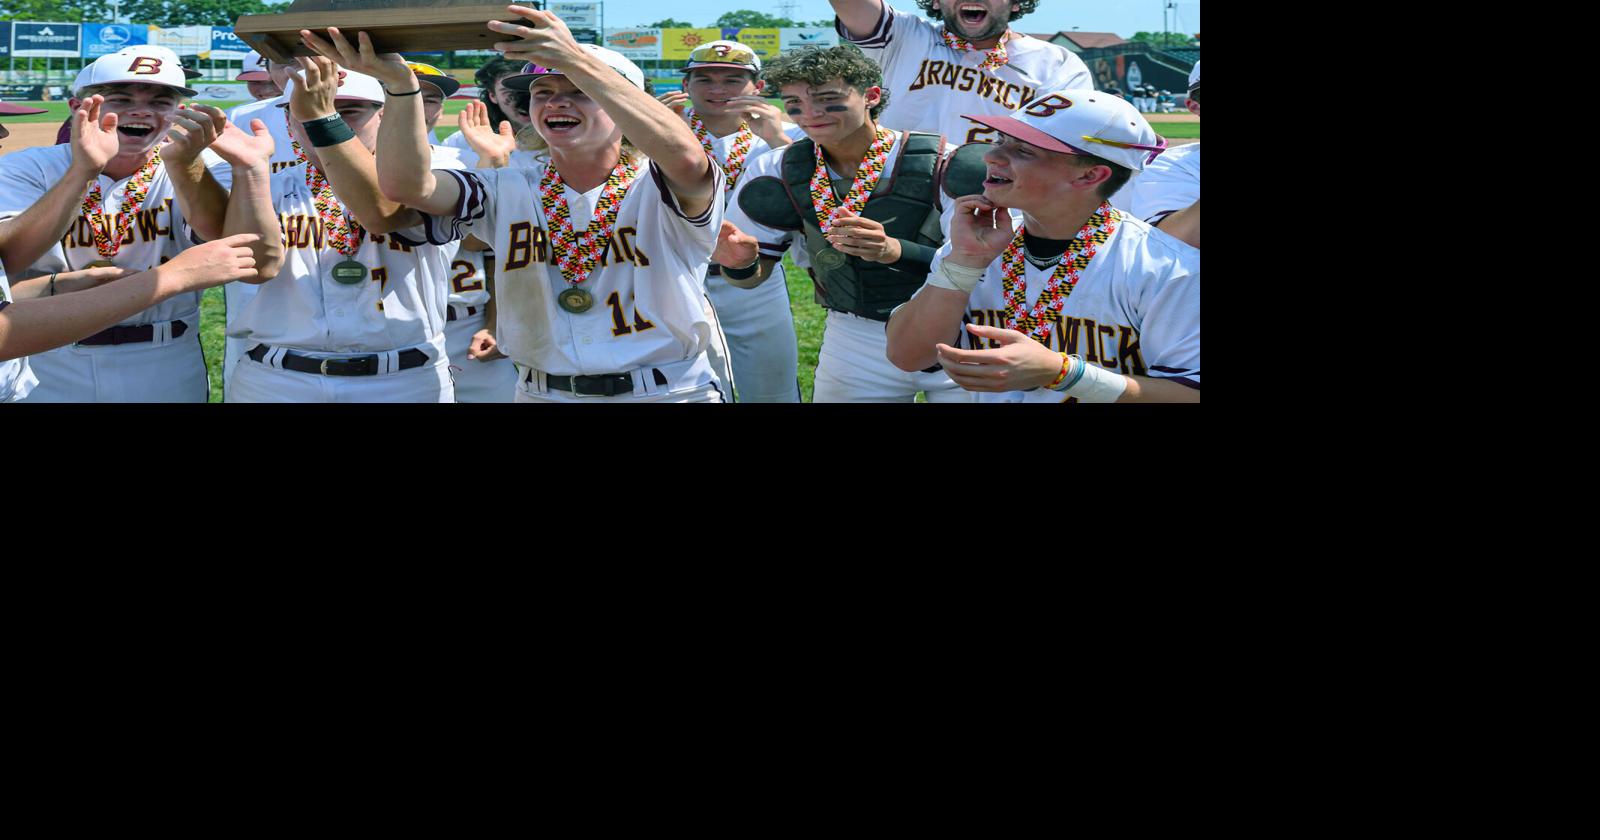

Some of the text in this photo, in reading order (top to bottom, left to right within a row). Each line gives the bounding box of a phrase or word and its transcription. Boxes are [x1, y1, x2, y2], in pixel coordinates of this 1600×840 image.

[127, 56, 163, 75] B
[1024, 93, 1074, 118] B
[450, 259, 484, 293] 2
